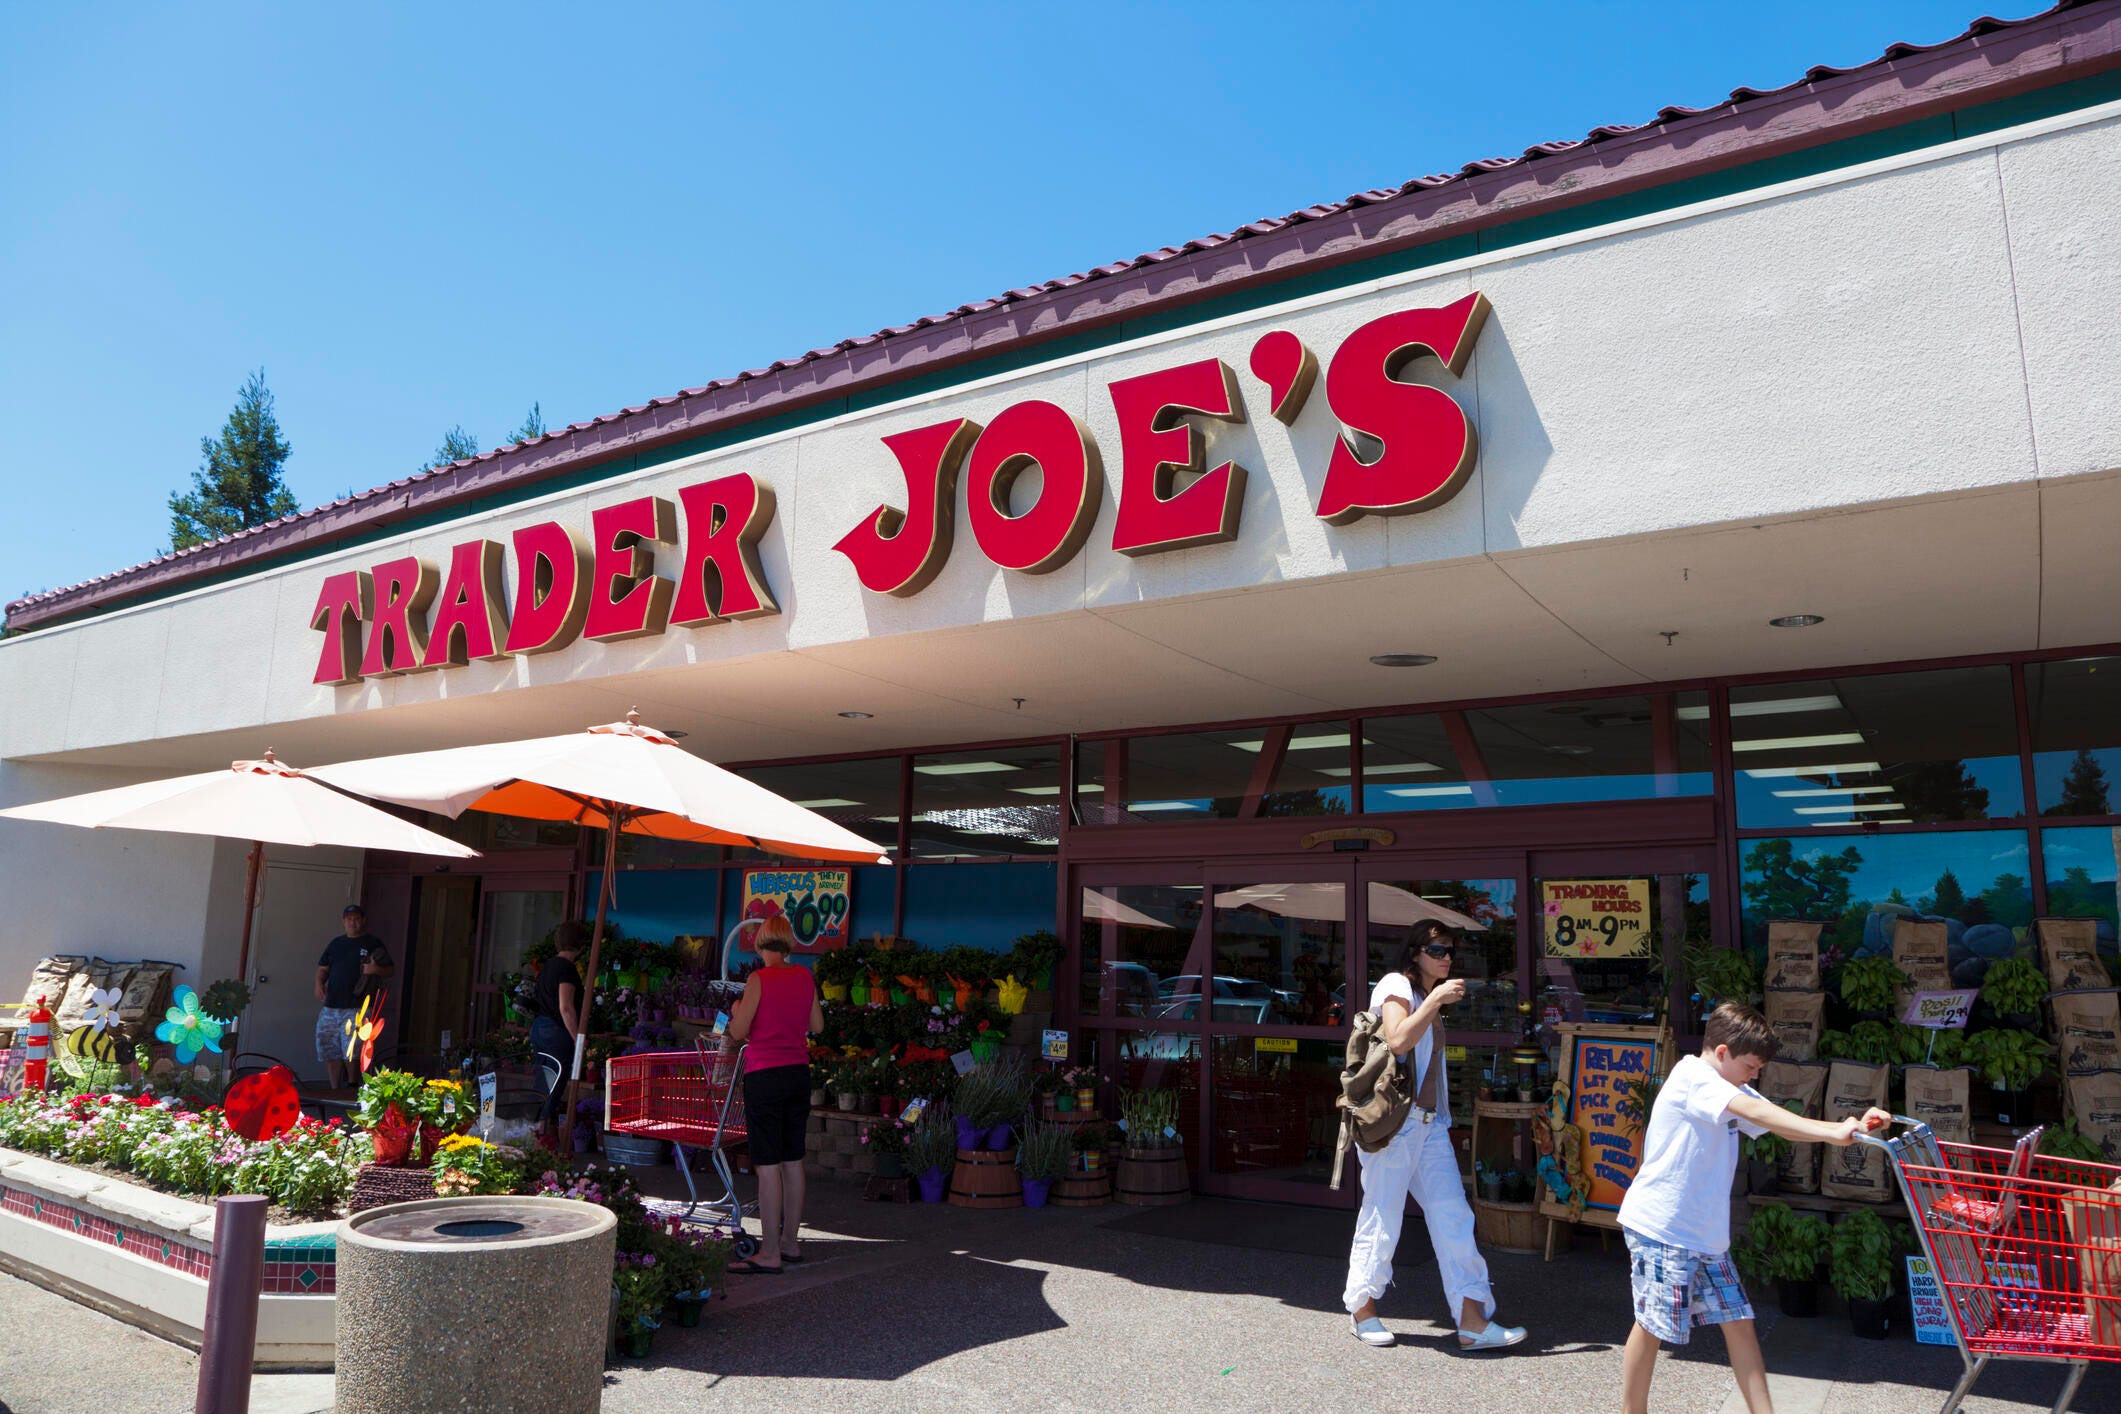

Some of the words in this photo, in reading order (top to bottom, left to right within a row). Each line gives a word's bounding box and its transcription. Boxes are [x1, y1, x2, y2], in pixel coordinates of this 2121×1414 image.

[309, 471, 782, 686] TRADER
[831, 290, 1492, 598] JOE'S
[1549, 884, 1629, 900] TRADING
[1592, 900, 1642, 913] HOURS
[1582, 1074, 1609, 1089] LET
[1613, 1077, 1631, 1096] US
[1579, 1093, 1610, 1110] PICK
[1591, 1112, 1617, 1127] THE
[1589, 1131, 1633, 1153] DINNER
[1601, 1148, 1637, 1169] MENU
[1914, 1307, 1942, 1317] LONG
